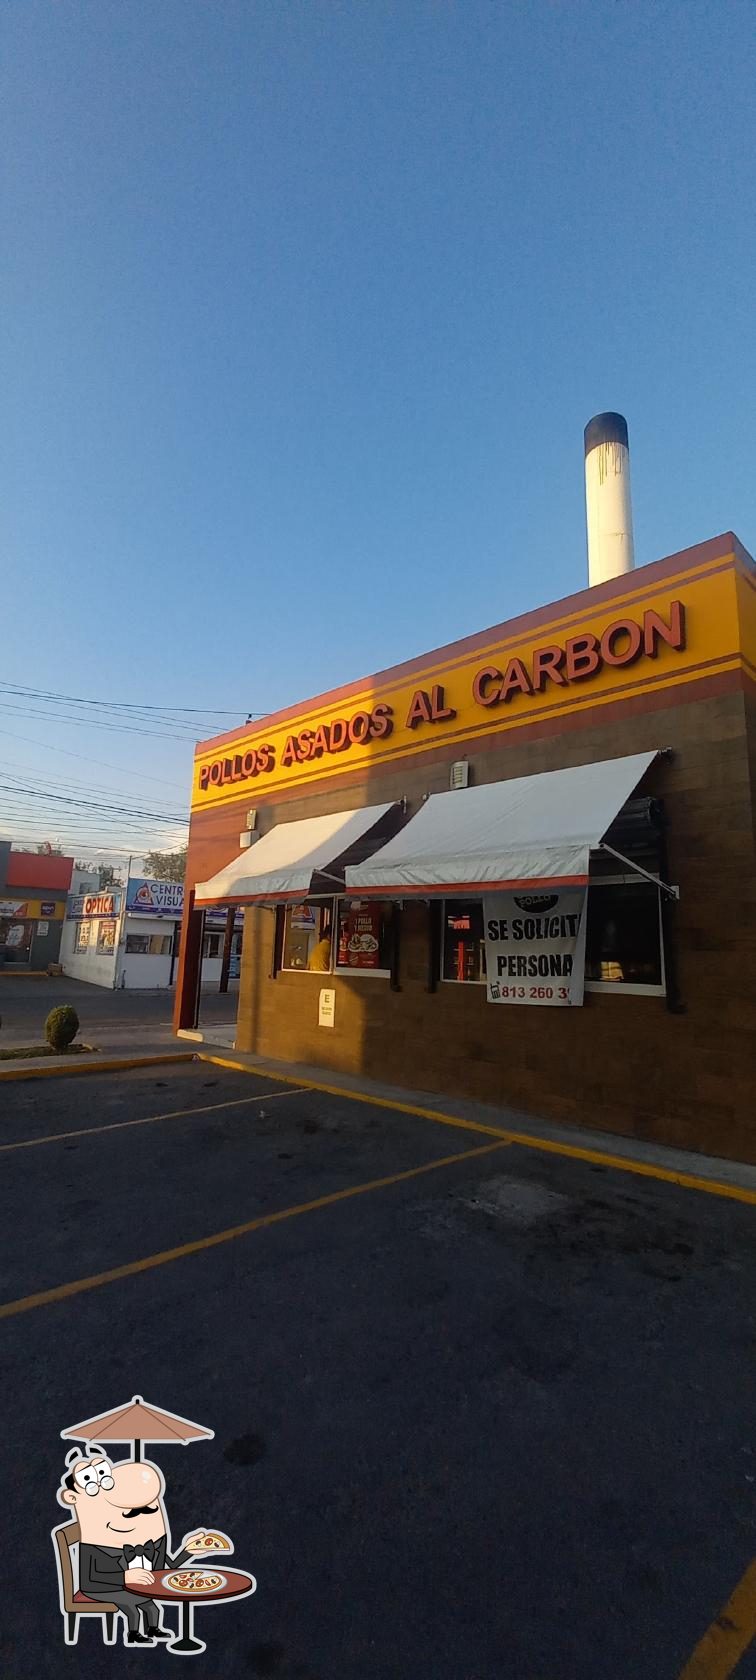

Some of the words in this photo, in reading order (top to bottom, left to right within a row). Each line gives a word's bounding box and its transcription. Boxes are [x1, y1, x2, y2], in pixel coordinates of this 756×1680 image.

[200, 744, 275, 790] POLLOS
[281, 704, 393, 767] ASADOS
[405, 685, 456, 729] AL
[472, 601, 685, 707] CARBON
[85, 896, 114, 913] OPTICA
[488, 919, 508, 941] SE
[512, 914, 581, 941] SOLICIT
[497, 953, 573, 978] PERSONA
[324, 993, 331, 1004] E
[502, 986, 526, 998] 813
[530, 987, 553, 999] 260
[558, 987, 570, 999] 3
